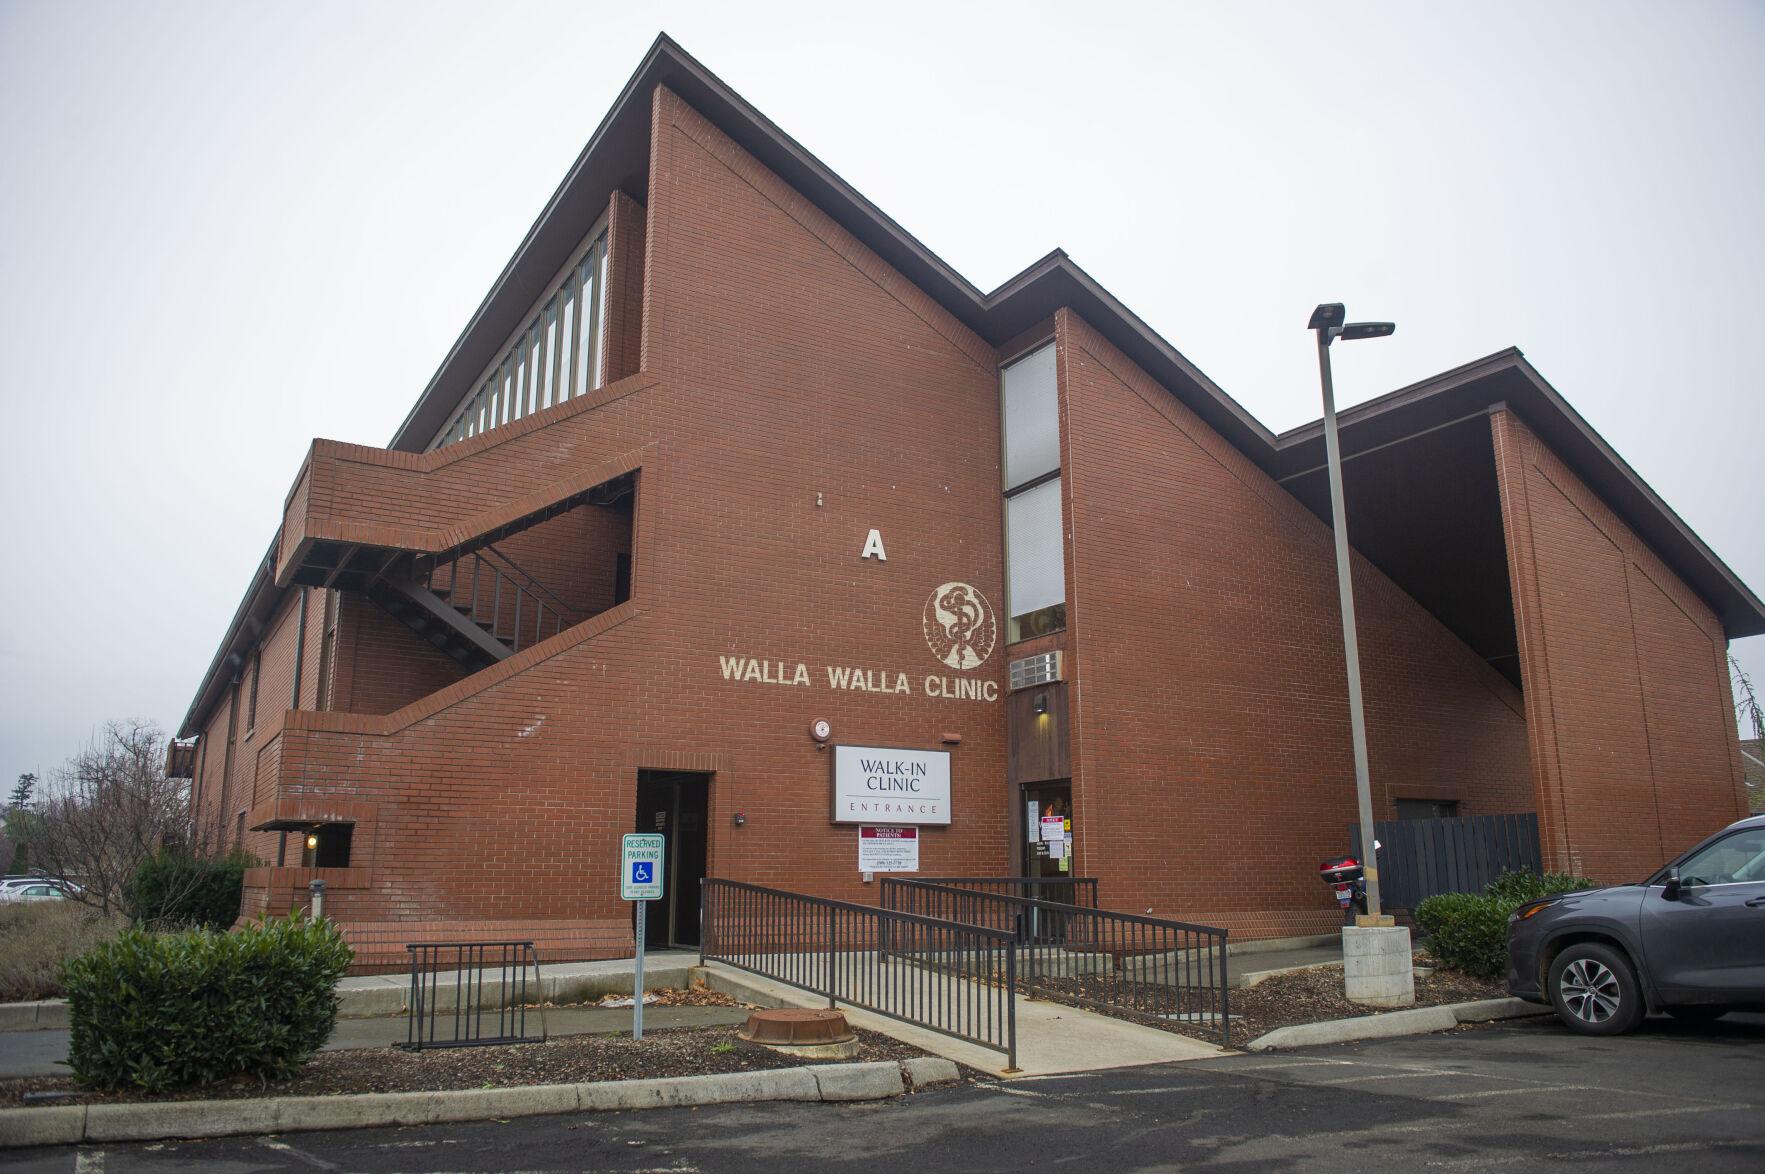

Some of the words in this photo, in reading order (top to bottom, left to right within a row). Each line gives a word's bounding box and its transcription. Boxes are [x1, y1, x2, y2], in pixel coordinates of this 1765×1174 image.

[862, 529, 887, 560] A
[720, 656, 811, 686] WALLA
[827, 665, 911, 695] WALLA
[925, 675, 998, 701] CLINIC
[861, 759, 926, 776] WALK-IN
[867, 776, 920, 792] CLINIC
[850, 802, 937, 813] ENTRANCE
[626, 839, 660, 848] RESERVED
[628, 850, 659, 860] PARKING
